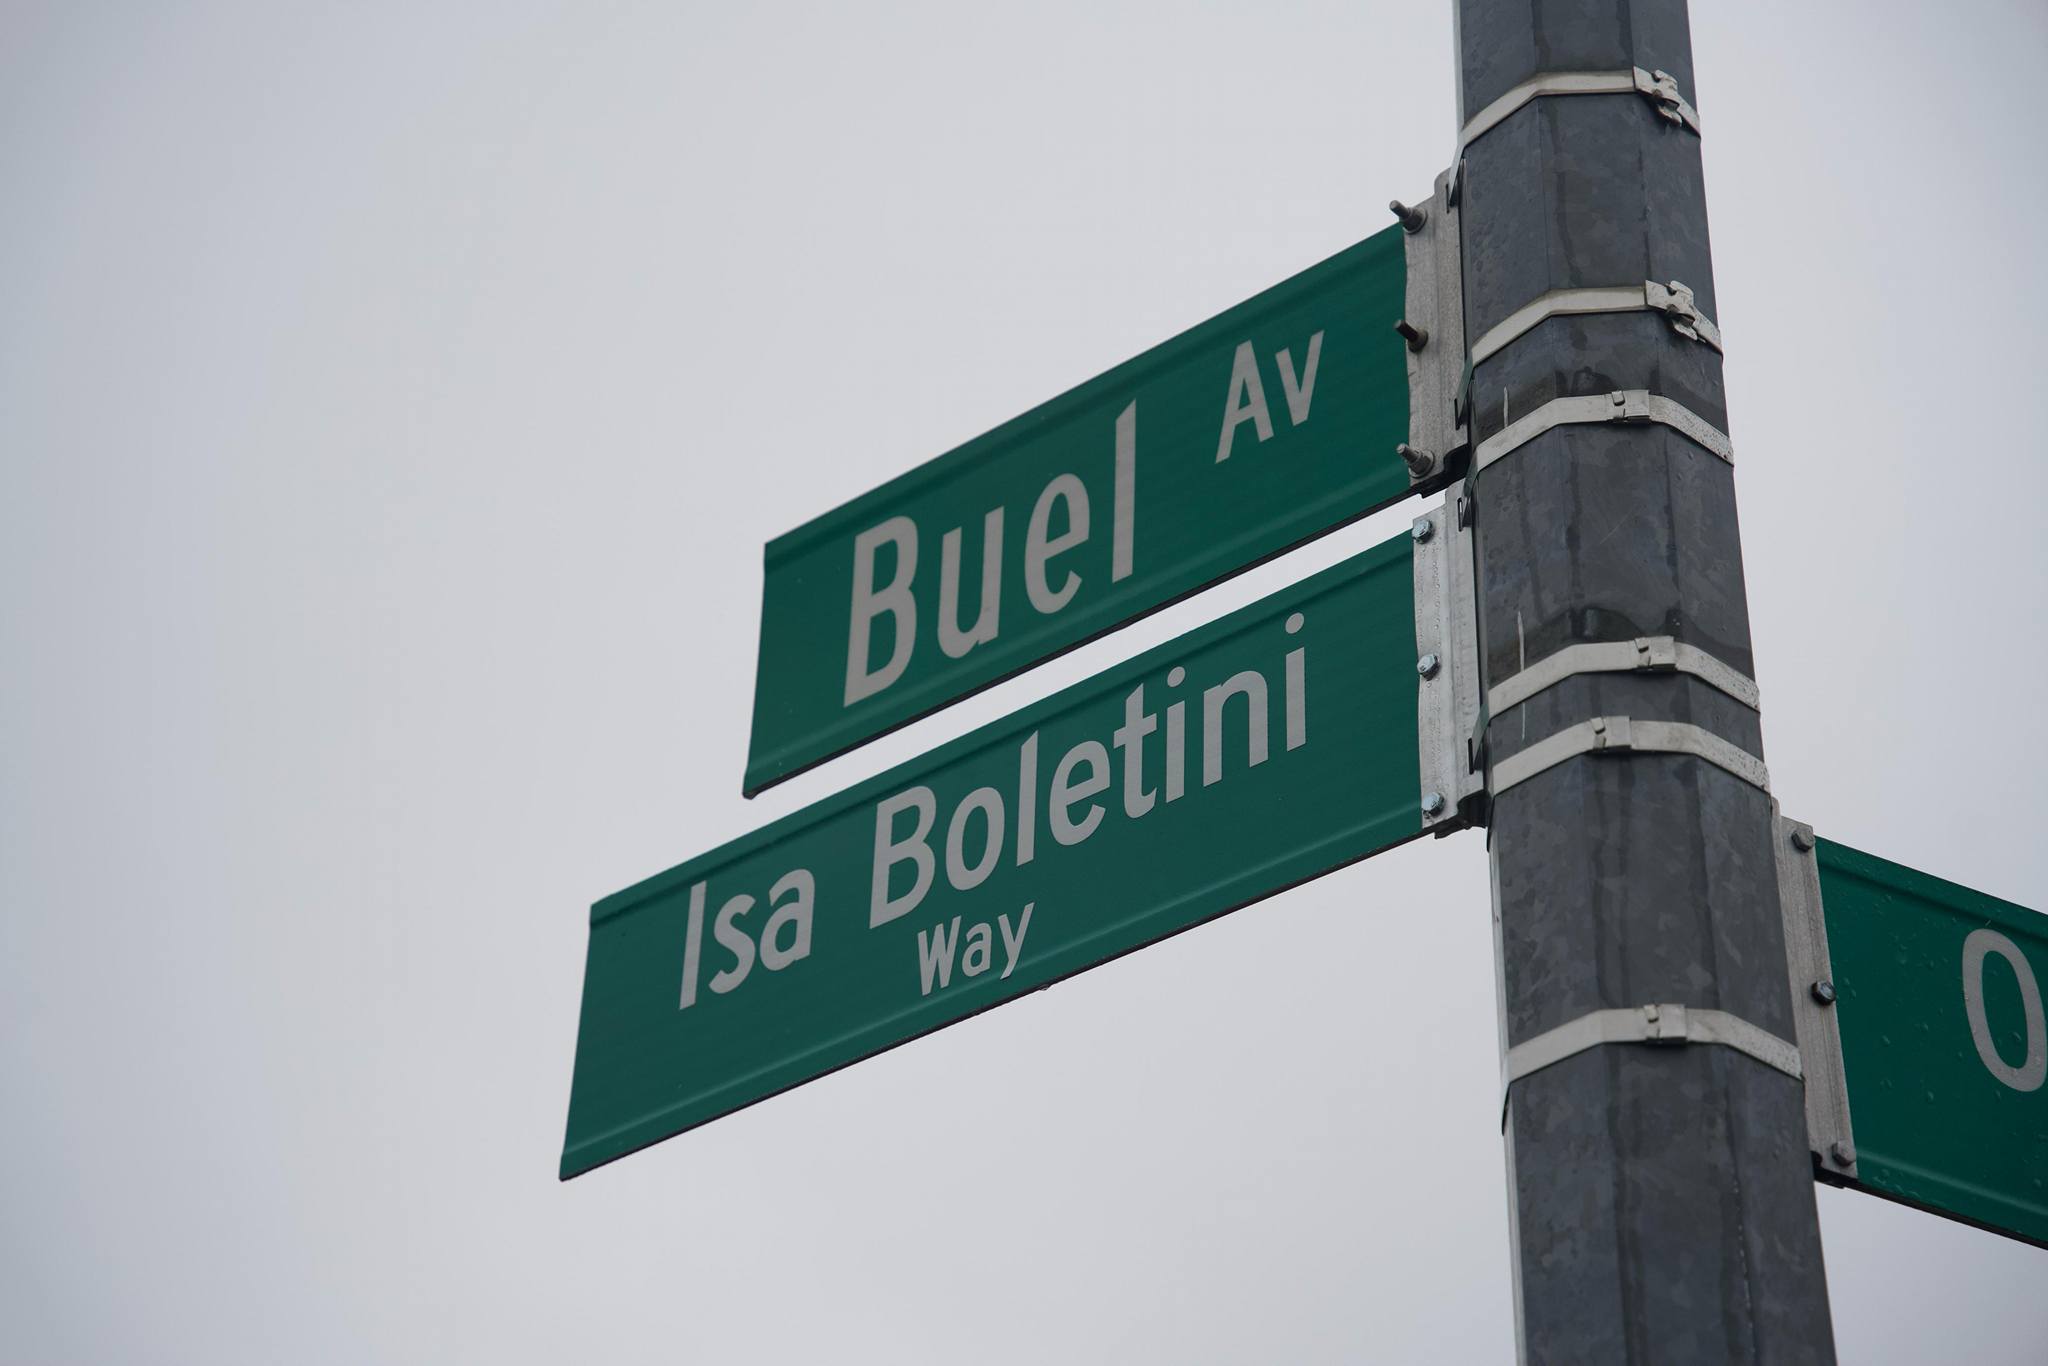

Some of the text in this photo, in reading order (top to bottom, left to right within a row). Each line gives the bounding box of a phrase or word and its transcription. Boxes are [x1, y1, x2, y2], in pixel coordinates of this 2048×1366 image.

[844, 331, 1324, 708] Buel Av
[679, 612, 1307, 1009] Isa Boletini
[916, 902, 1035, 997] Way
